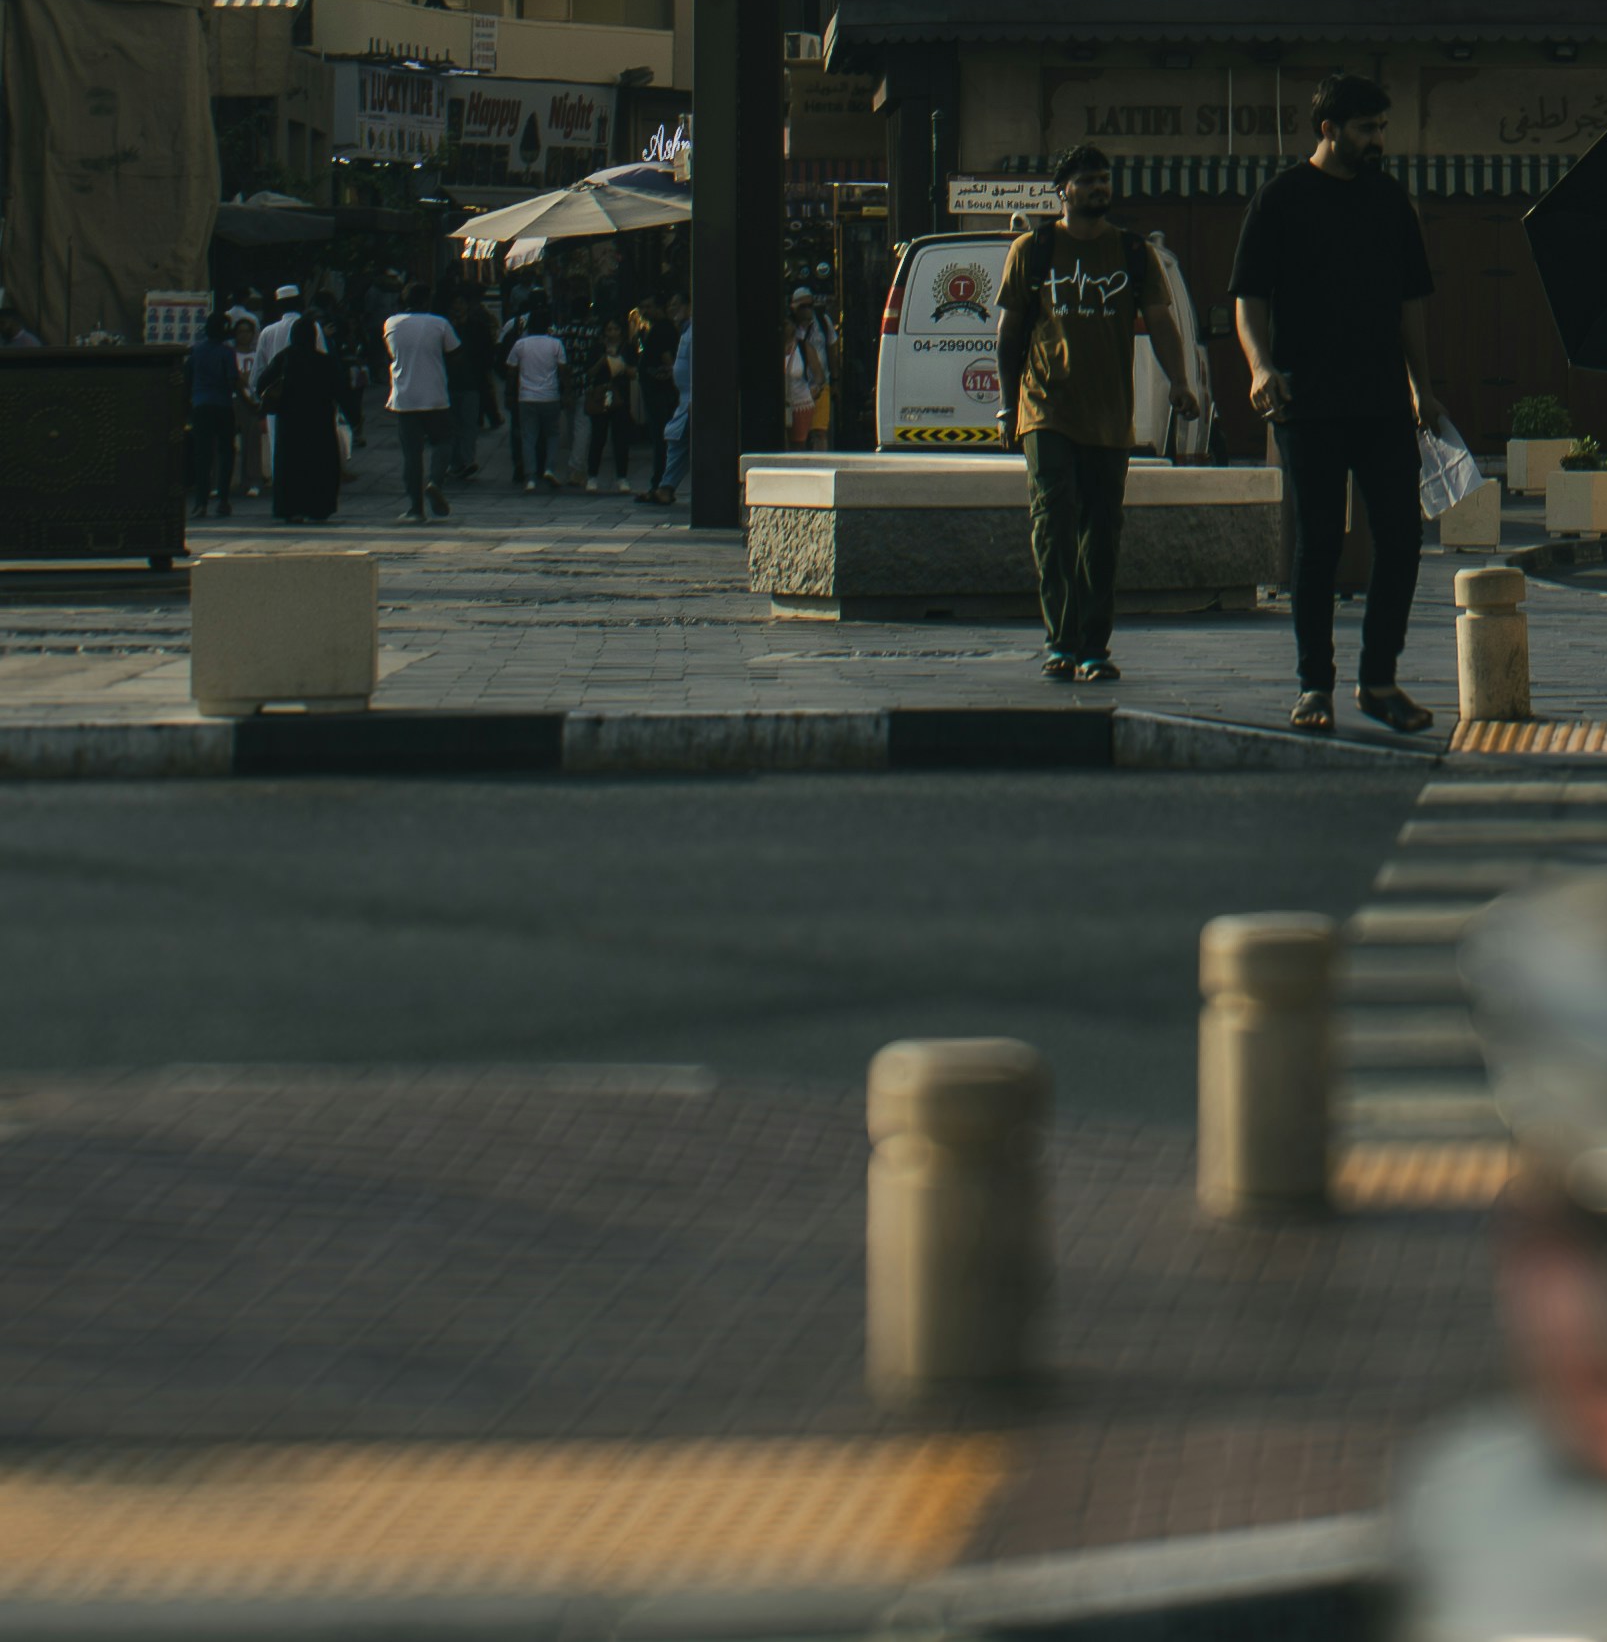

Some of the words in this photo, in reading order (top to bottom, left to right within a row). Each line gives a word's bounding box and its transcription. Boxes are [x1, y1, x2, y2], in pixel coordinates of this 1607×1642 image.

[466, 91, 522, 138] Happy
[548, 92, 594, 139] Night
[1085, 105, 1184, 136] LATIFI
[1196, 104, 1299, 136] STORE
[958, 184, 988, 196] الكبير
[991, 186, 1024, 197] السوق
[955, 199, 965, 210] Al
[968, 199, 992, 211] Souq
[994, 199, 1004, 210] Al
[1007, 199, 1040, 210] Kabeer
[956, 279, 971, 297] T
